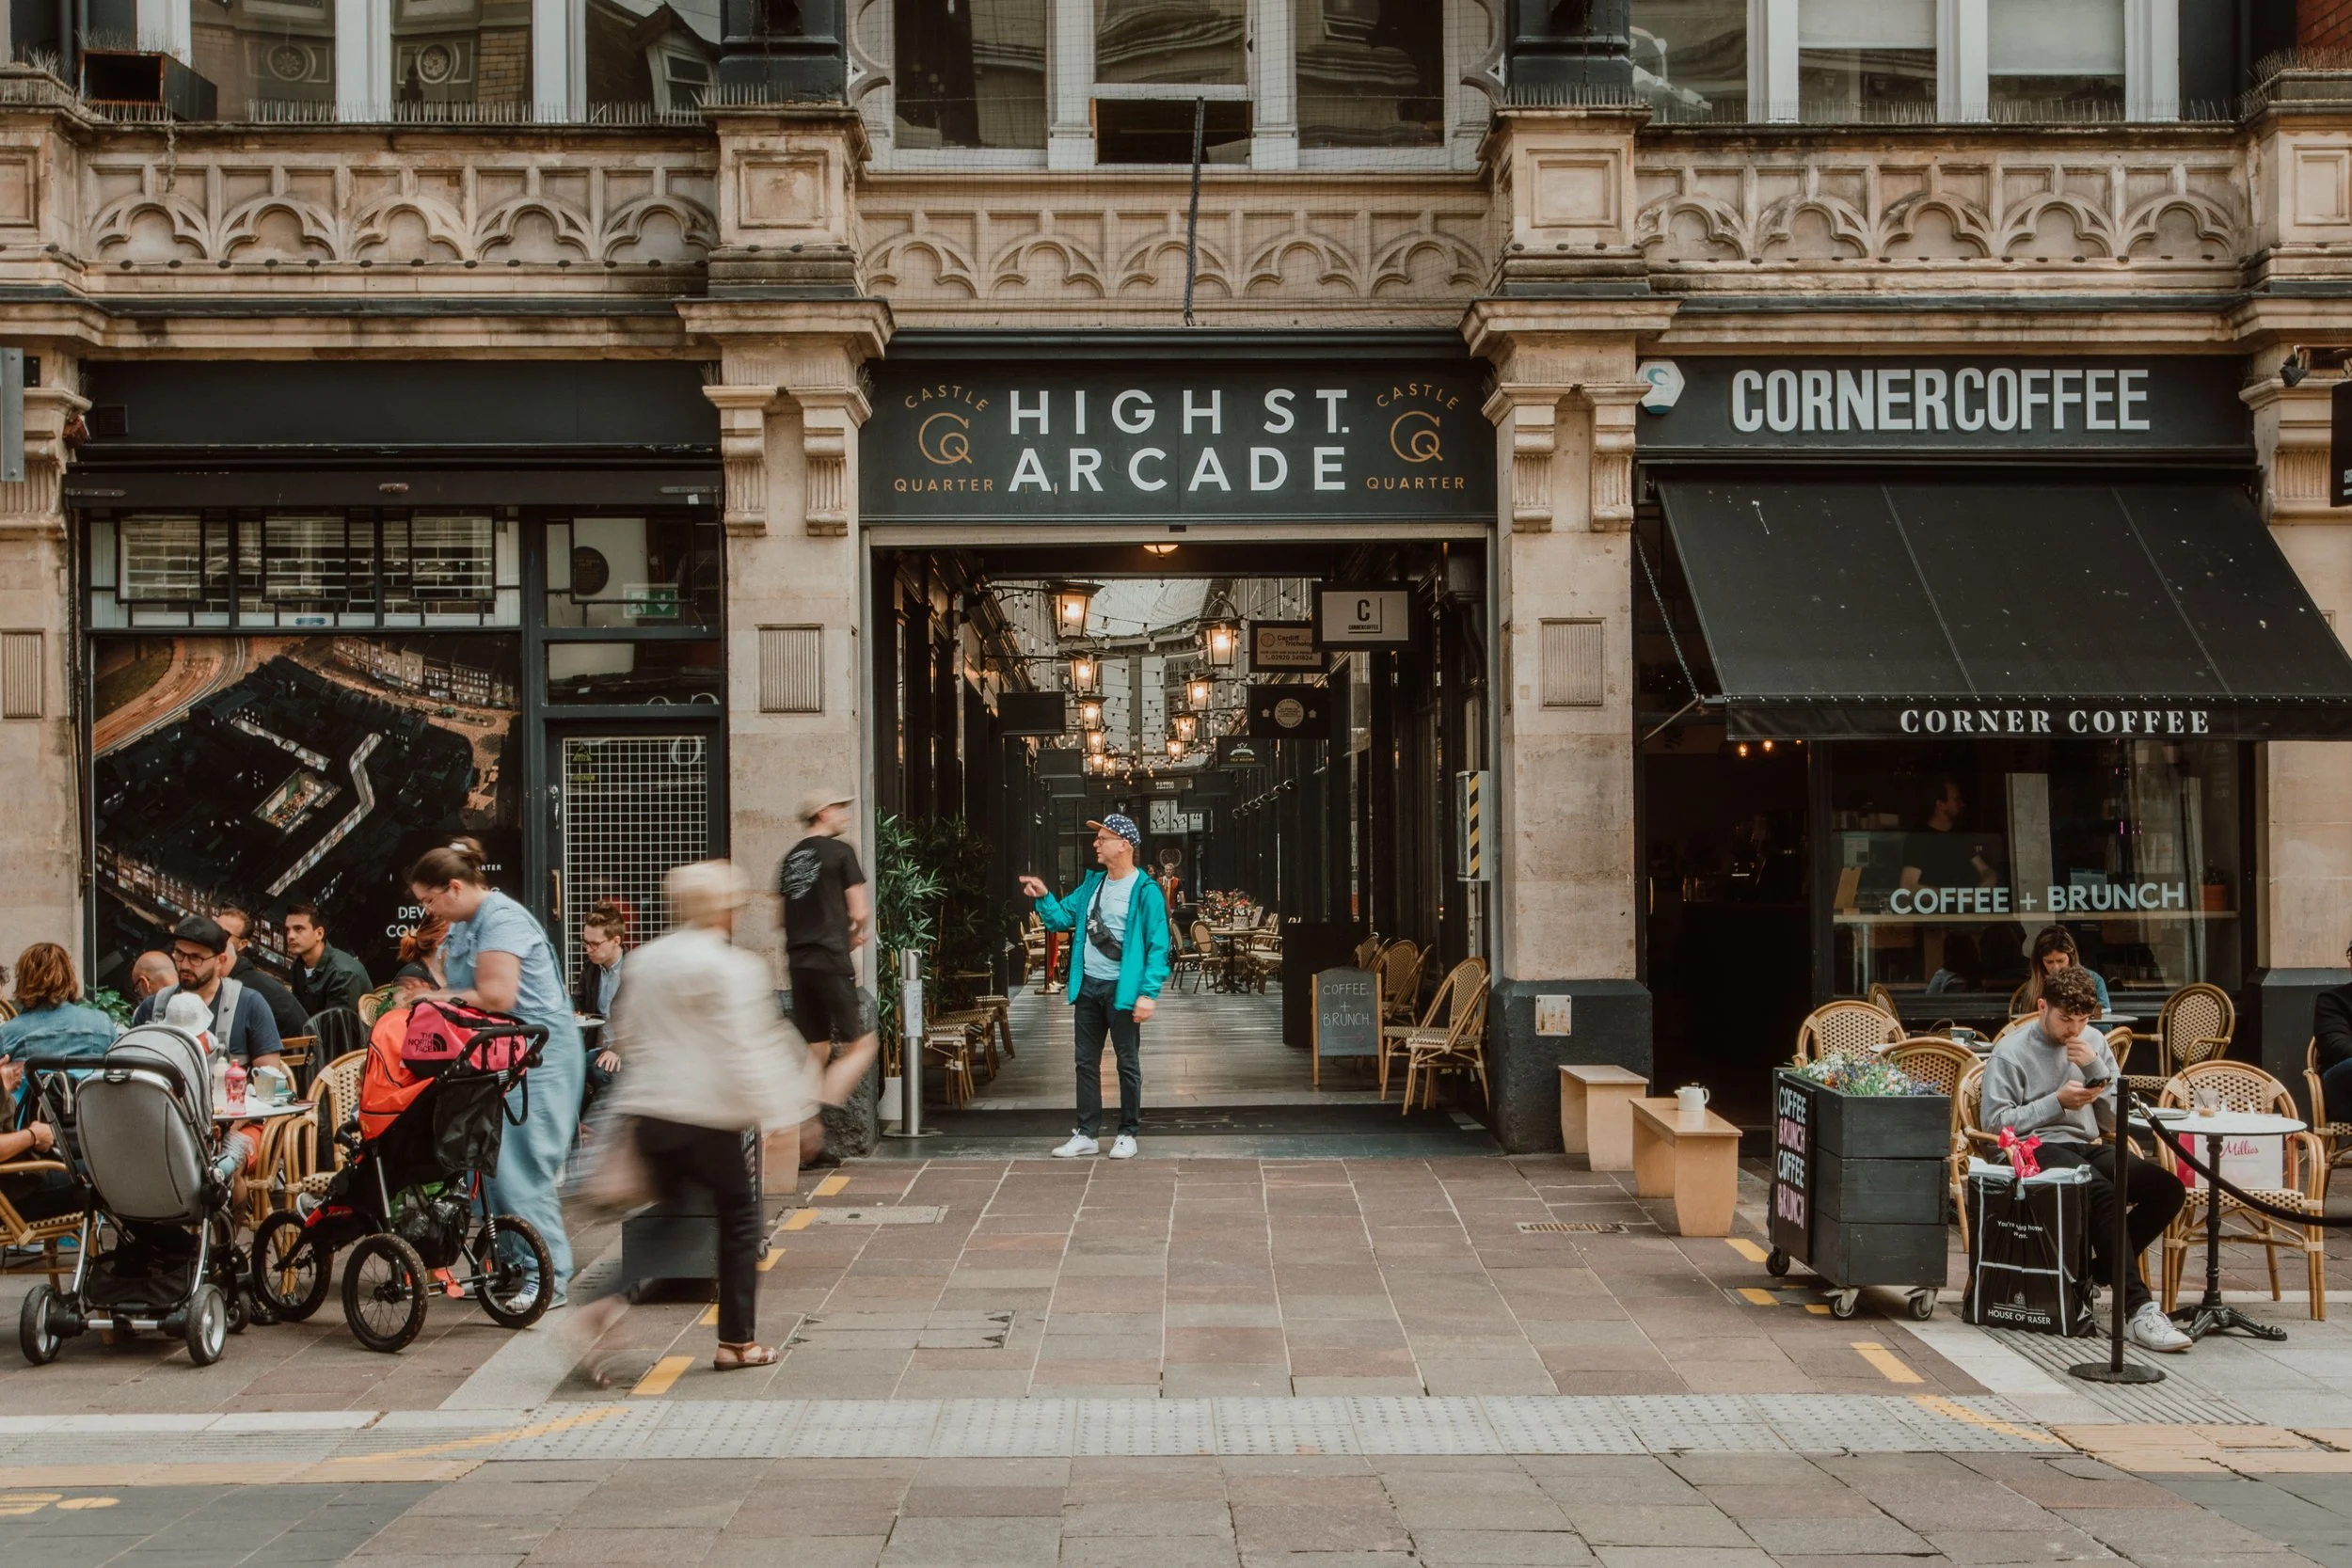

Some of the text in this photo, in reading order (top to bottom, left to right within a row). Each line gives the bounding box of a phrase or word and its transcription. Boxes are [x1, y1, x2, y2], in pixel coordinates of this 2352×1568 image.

[905, 385, 990, 412] CASTLE
[1376, 383, 1459, 410] CASTLE
[1009, 388, 1350, 436] HIGH ST.
[1008, 446, 1346, 493] ARCADE
[894, 478, 993, 493] QUARTER
[1366, 476, 1465, 490] QUARTER
[1357, 598, 1371, 623] C
[1900, 709, 2210, 734] CORNER COFFEE
[1889, 882, 2185, 914] COFFEE + BRUNCH
[1322, 982, 1368, 996] COFFEE
[1323, 1012, 1370, 1027] BRUNCH
[415, 1045, 433, 1053] FACE
[1778, 1085, 1807, 1125] COFFEE
[1777, 1117, 1806, 1155] BRUNCH
[1777, 1148, 1805, 1190] COFFEE
[1776, 1182, 1805, 1230] BRUNCH
[2027, 1224, 2043, 1232] home
[1987, 1308, 2052, 1325] HOUSE OF RASER
